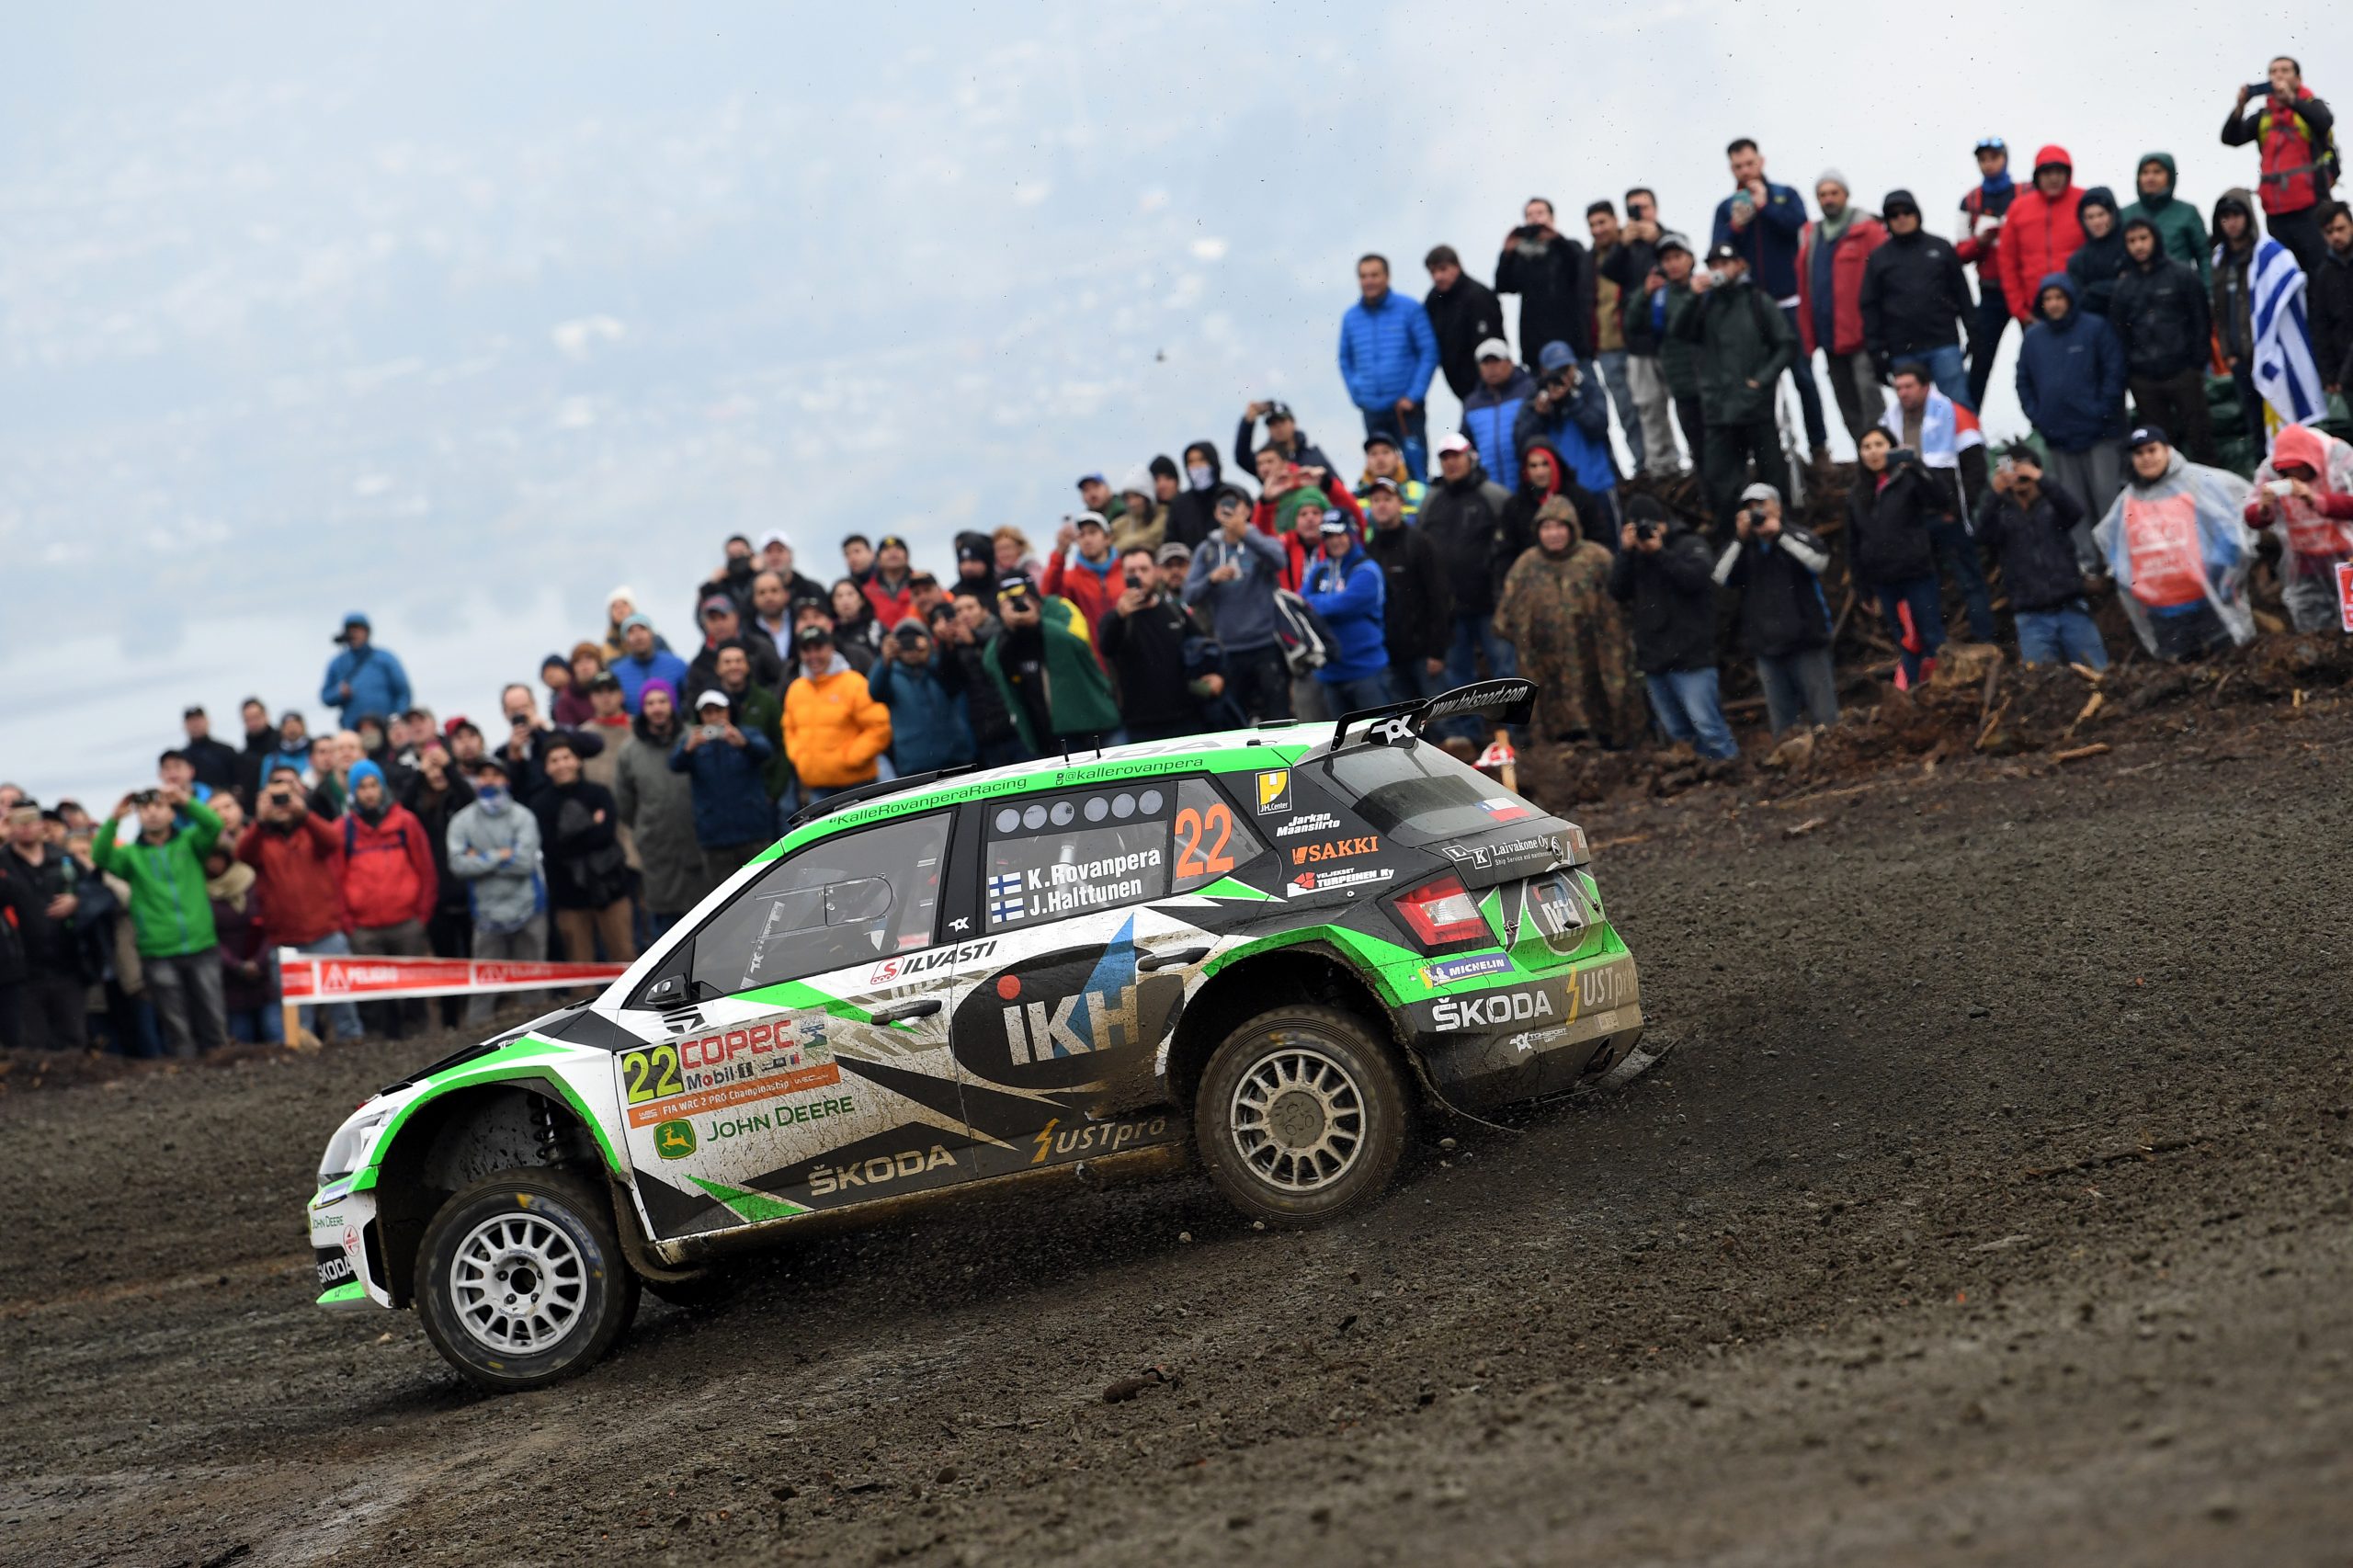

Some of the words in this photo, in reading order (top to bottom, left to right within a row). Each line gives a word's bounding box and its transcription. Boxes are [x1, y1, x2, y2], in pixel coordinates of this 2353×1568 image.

[1427, 685, 1529, 719] www.toksport.com
[1065, 757, 1204, 782] @kallerovanpera
[1276, 819, 1341, 837] Maansiirto
[1289, 812, 1332, 827] Jarkan
[1174, 802, 1235, 880] 22
[1308, 835, 1380, 862] SAKKI
[1489, 838, 1539, 857] Laivakone
[1538, 835, 1549, 849] Oy
[1029, 879, 1142, 916] J.Halttunen
[1449, 959, 1505, 976] MICHELIN
[1432, 990, 1553, 1031] ŠKODA
[621, 1045, 684, 1104] 22
[687, 1065, 734, 1090] Mobil
[662, 1104, 678, 1116] FIA
[678, 1099, 699, 1113] WRC
[700, 1097, 708, 1107] 2
[709, 1091, 726, 1105] PRO
[729, 1081, 790, 1101] Championship
[706, 1113, 771, 1142] JOHN
[775, 1096, 853, 1129] DEERE
[808, 1144, 957, 1196] ŠKODA
